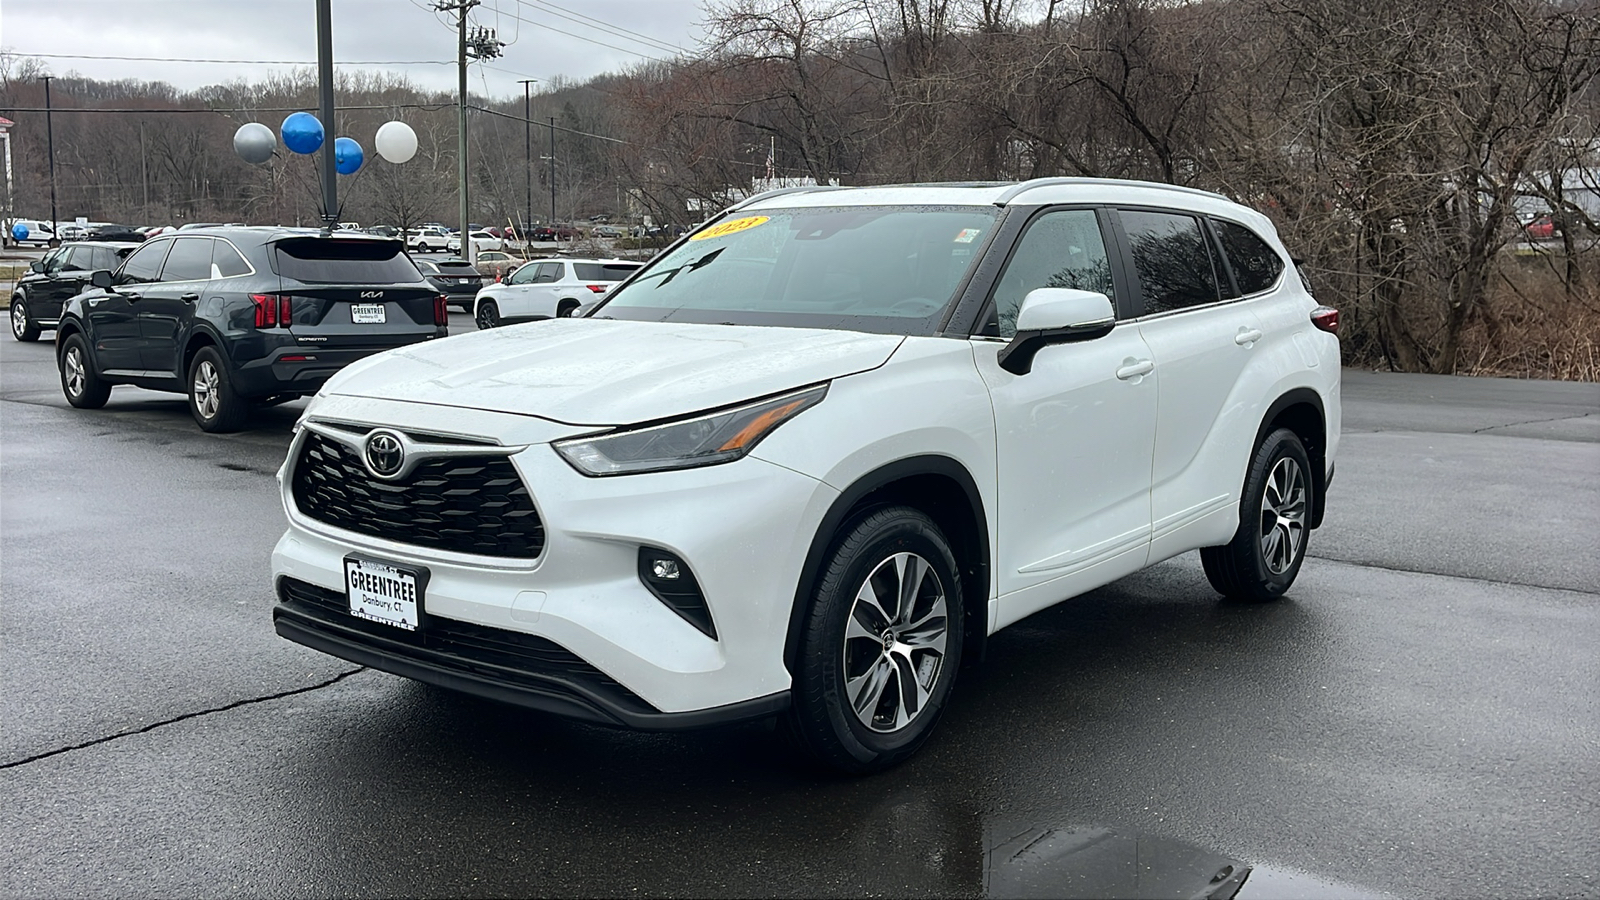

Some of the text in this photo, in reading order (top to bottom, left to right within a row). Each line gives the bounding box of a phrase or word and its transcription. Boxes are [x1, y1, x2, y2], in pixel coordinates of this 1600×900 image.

[700, 217, 759, 238] 2023
[351, 570, 414, 603] GREENTREE
[362, 593, 393, 612] Danbury,
[350, 610, 415, 632] GREENTREE
